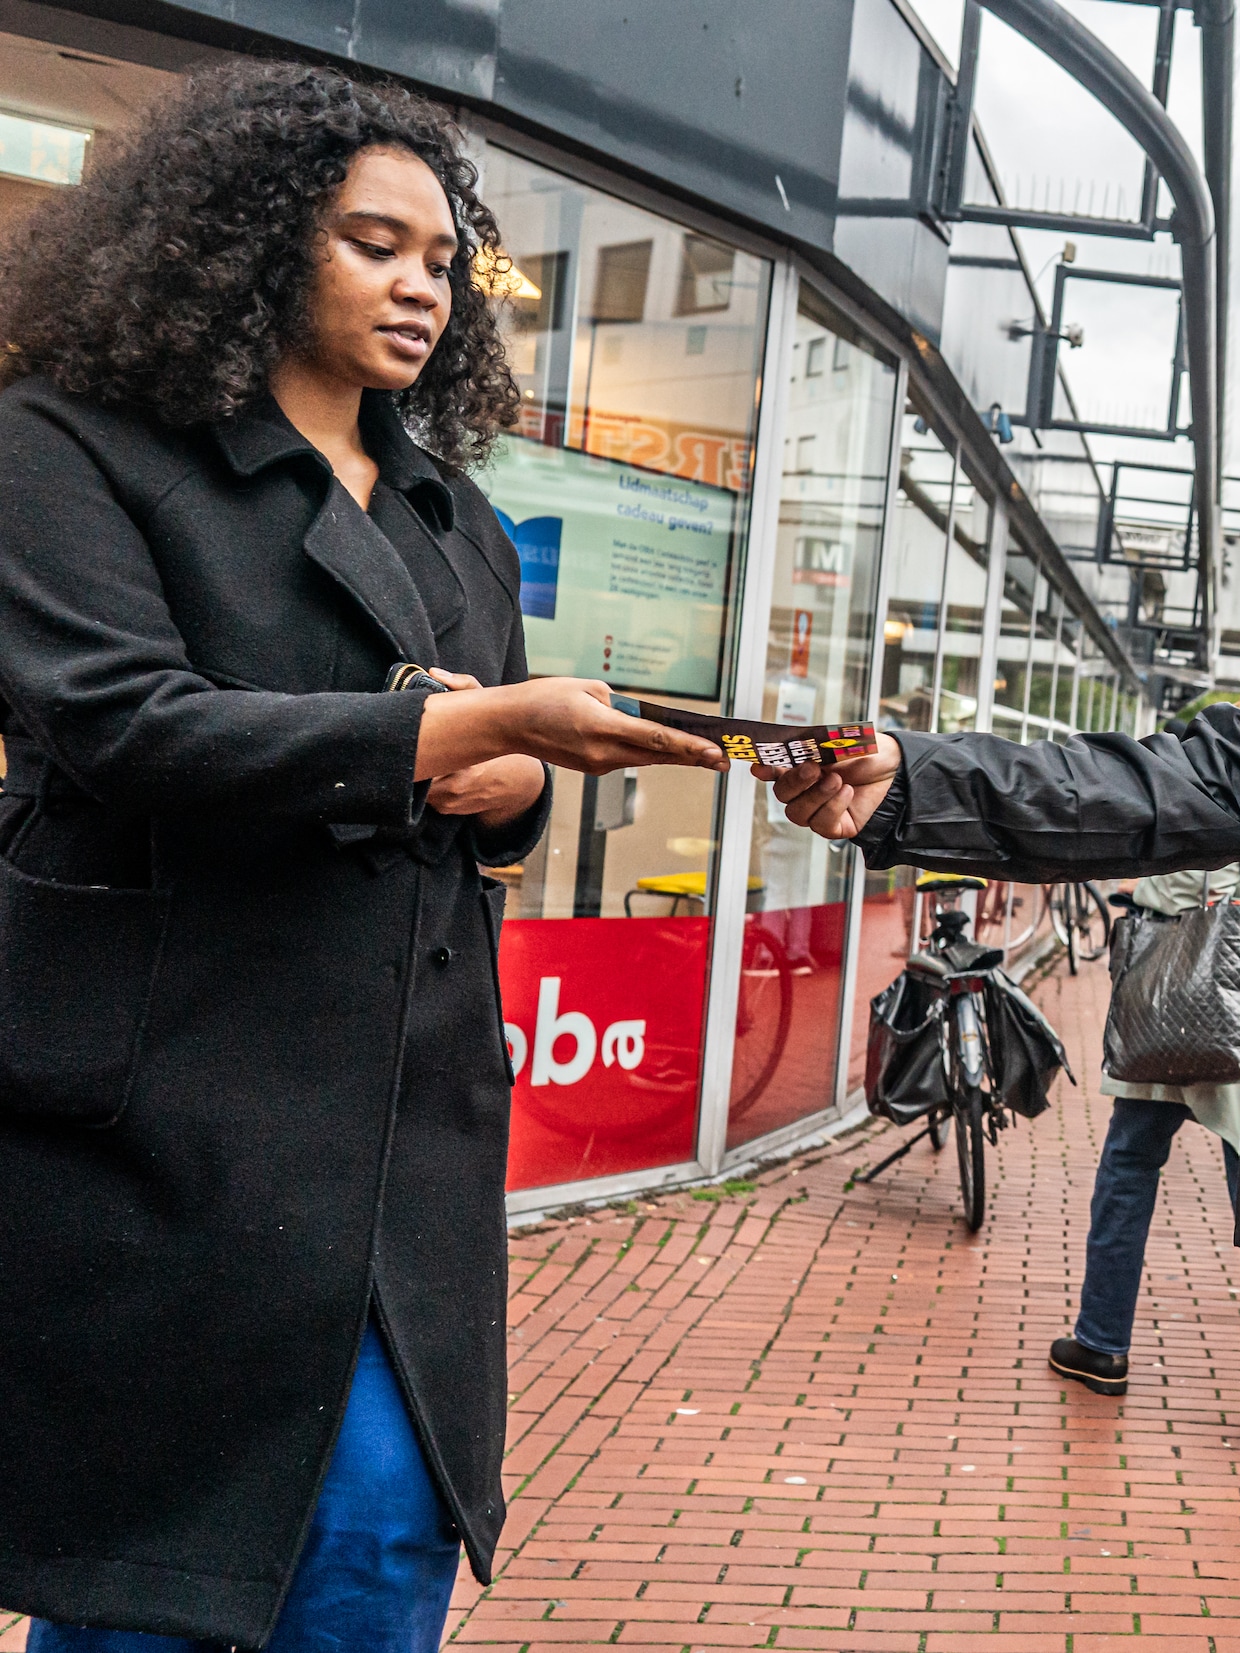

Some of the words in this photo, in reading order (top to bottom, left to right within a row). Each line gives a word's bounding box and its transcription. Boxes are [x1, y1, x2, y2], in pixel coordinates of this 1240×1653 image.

[619, 474, 709, 512] Lidmaatschap
[617, 503, 664, 524] cadeau
[668, 516, 713, 536] geven?
